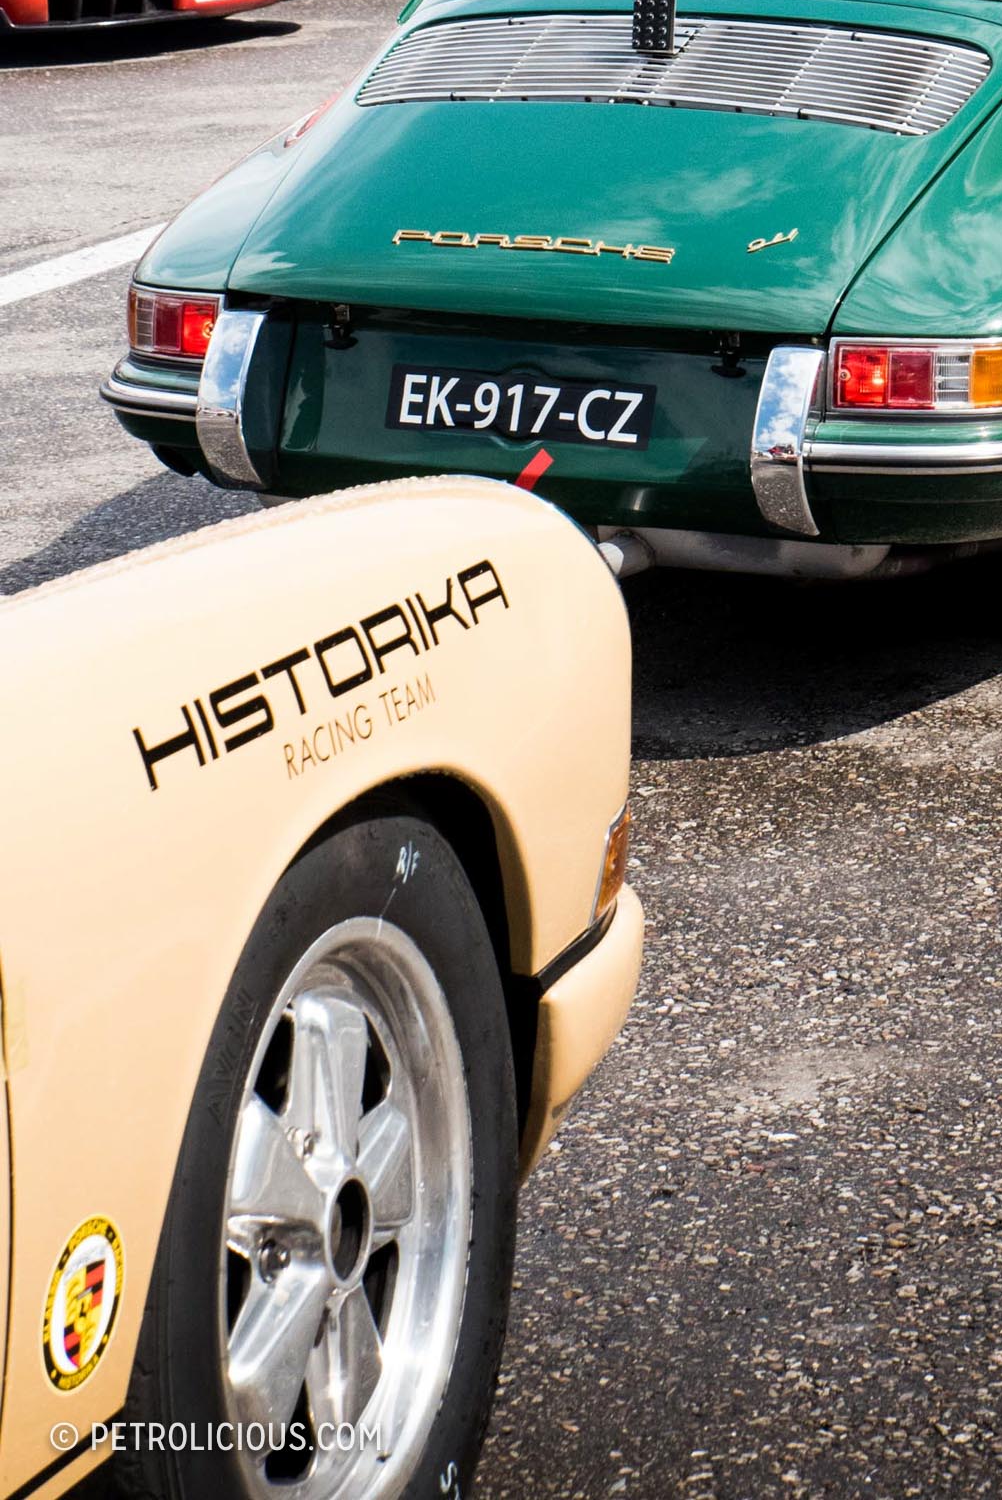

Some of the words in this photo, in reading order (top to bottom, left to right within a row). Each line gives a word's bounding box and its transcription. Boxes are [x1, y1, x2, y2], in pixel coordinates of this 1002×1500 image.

[392, 228, 676, 264] PORSCHE
[398, 373, 644, 444] EK-917-CZ
[132, 559, 509, 792] HISTORIKA
[283, 704, 374, 780] RACING
[379, 672, 437, 728] TEAM
